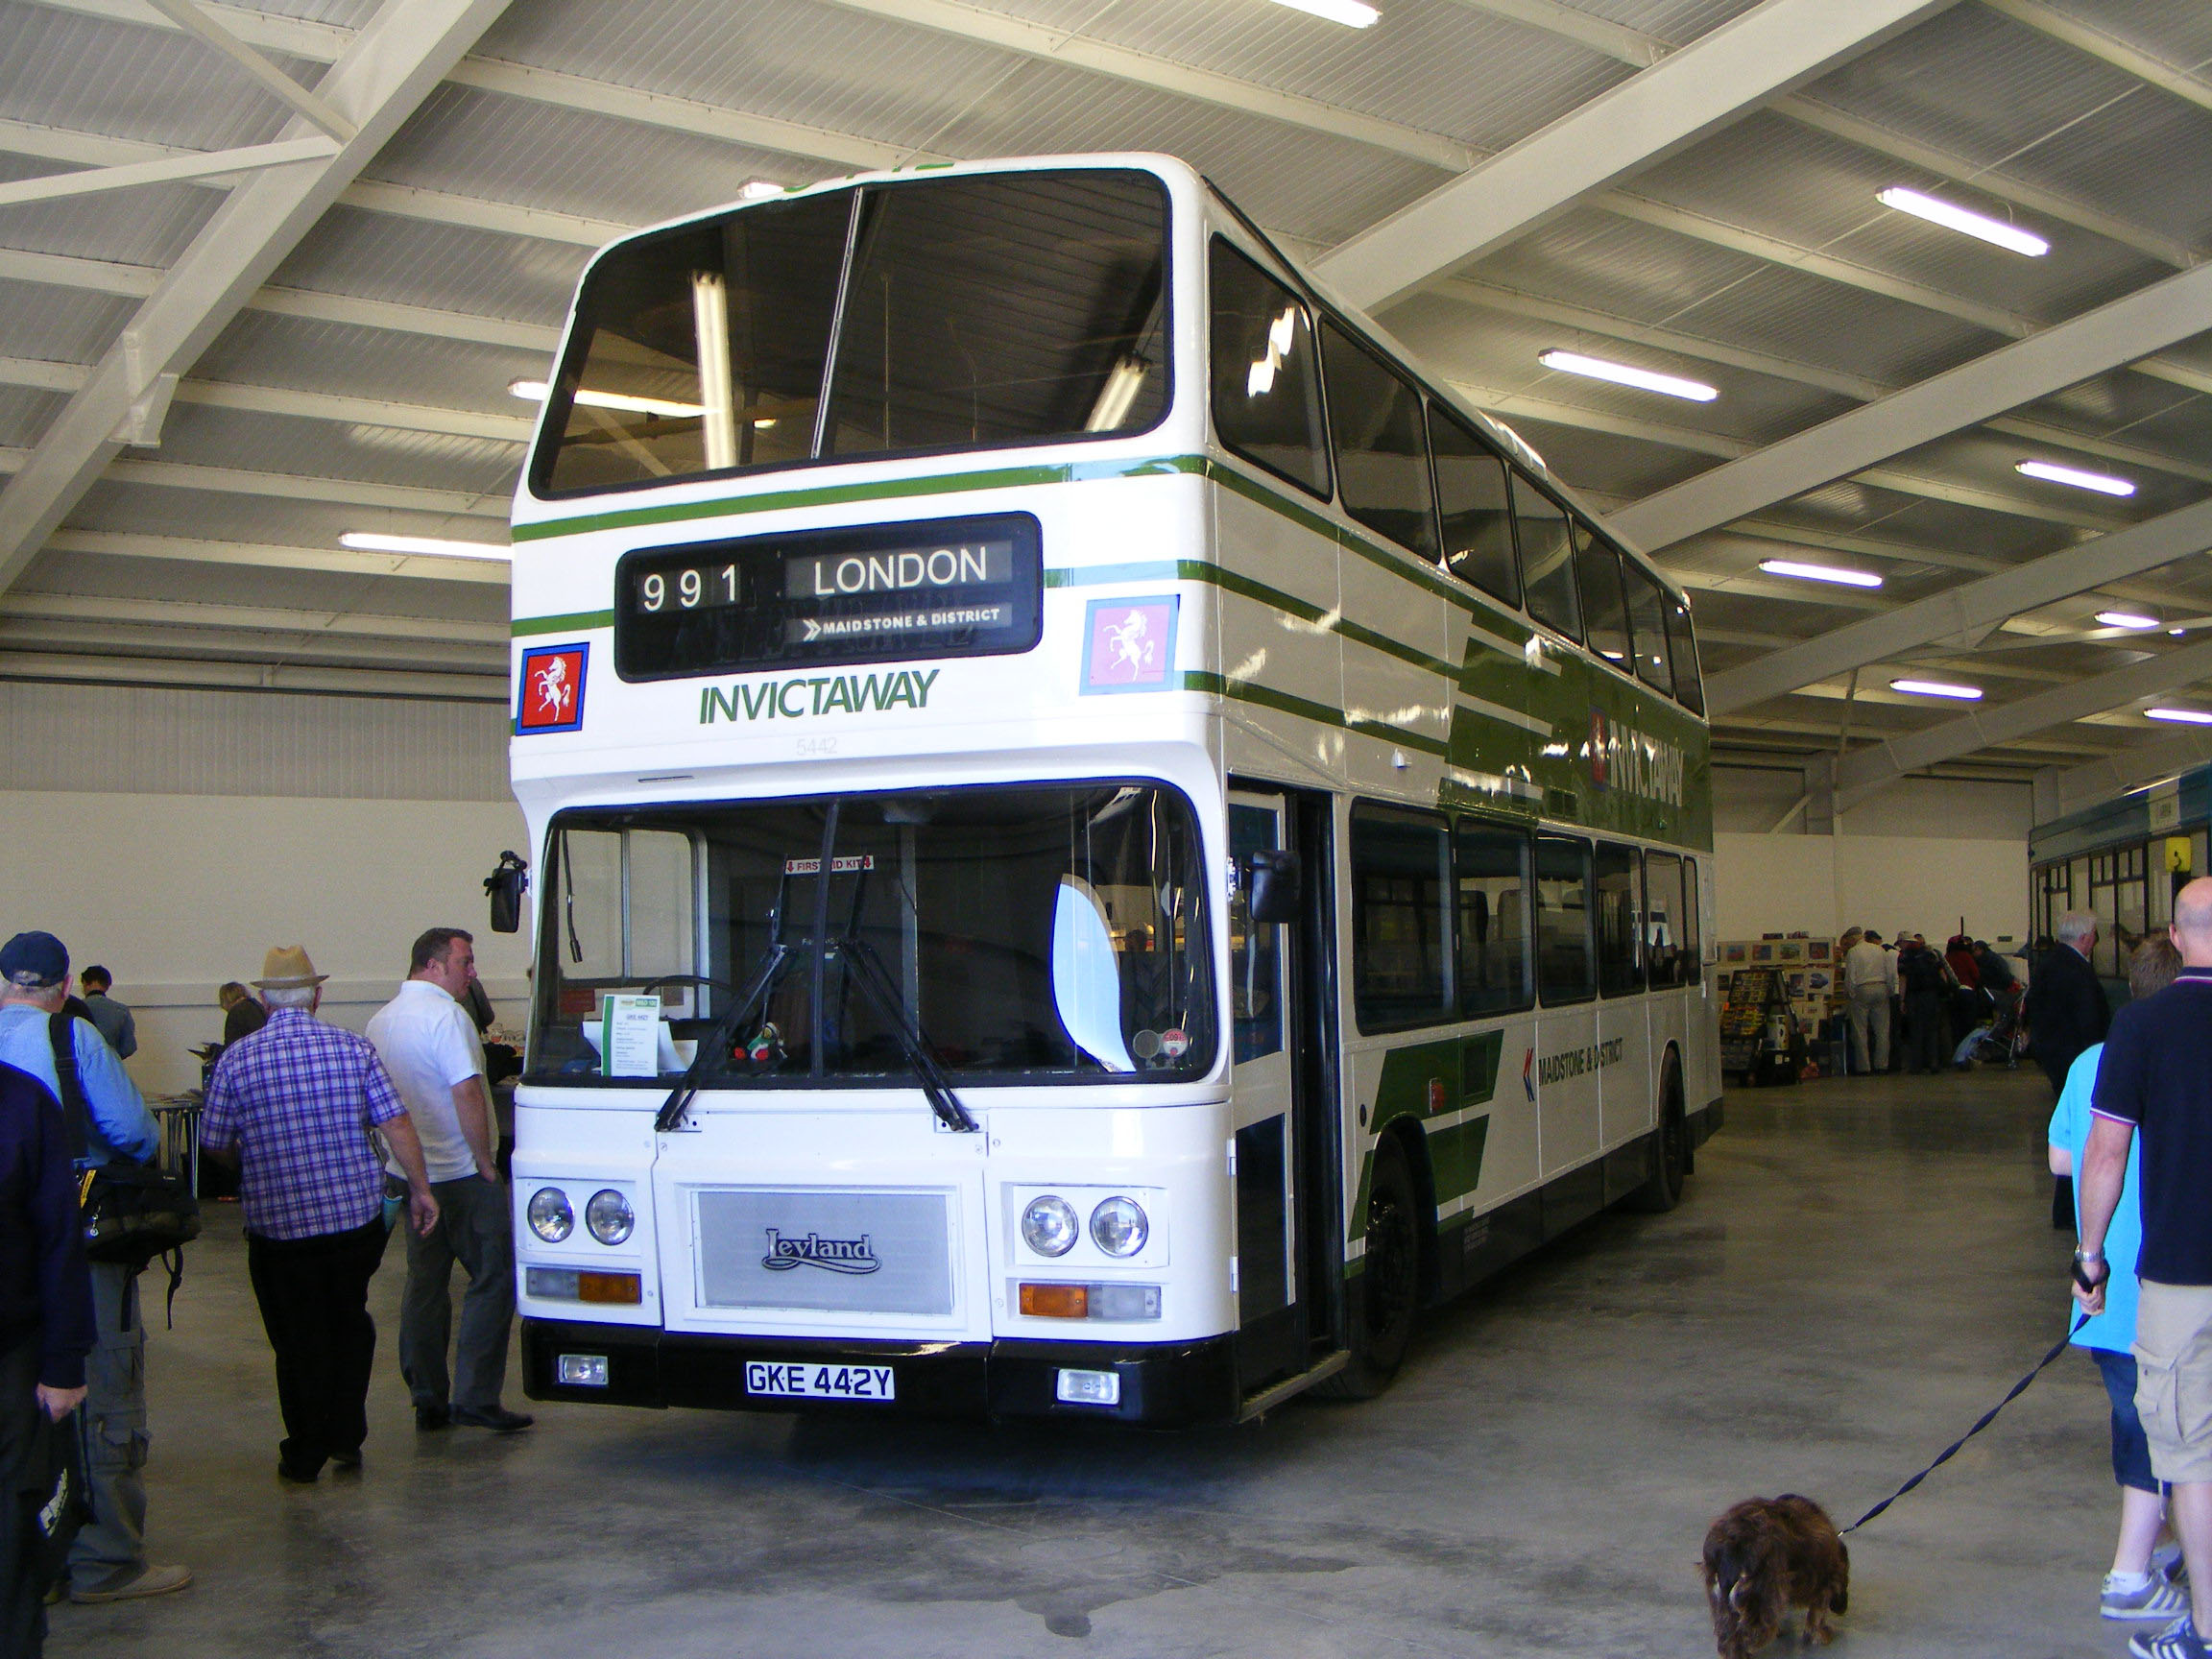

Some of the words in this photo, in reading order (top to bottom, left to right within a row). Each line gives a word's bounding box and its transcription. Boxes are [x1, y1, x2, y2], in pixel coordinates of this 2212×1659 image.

[815, 546, 987, 595] LONDON
[823, 614, 912, 635] MAIDSTONE
[916, 613, 927, 626] &
[931, 608, 1000, 624] DISTRICT
[700, 669, 940, 724] INVICTAWAY
[796, 736, 838, 757] 5442
[1538, 1048, 1584, 1087] MAIDSTONE
[1594, 1037, 1623, 1070] DSTRICT
[764, 1228, 878, 1266] Leyland
[749, 1364, 805, 1393] GKE
[814, 1366, 891, 1396] 442Y
